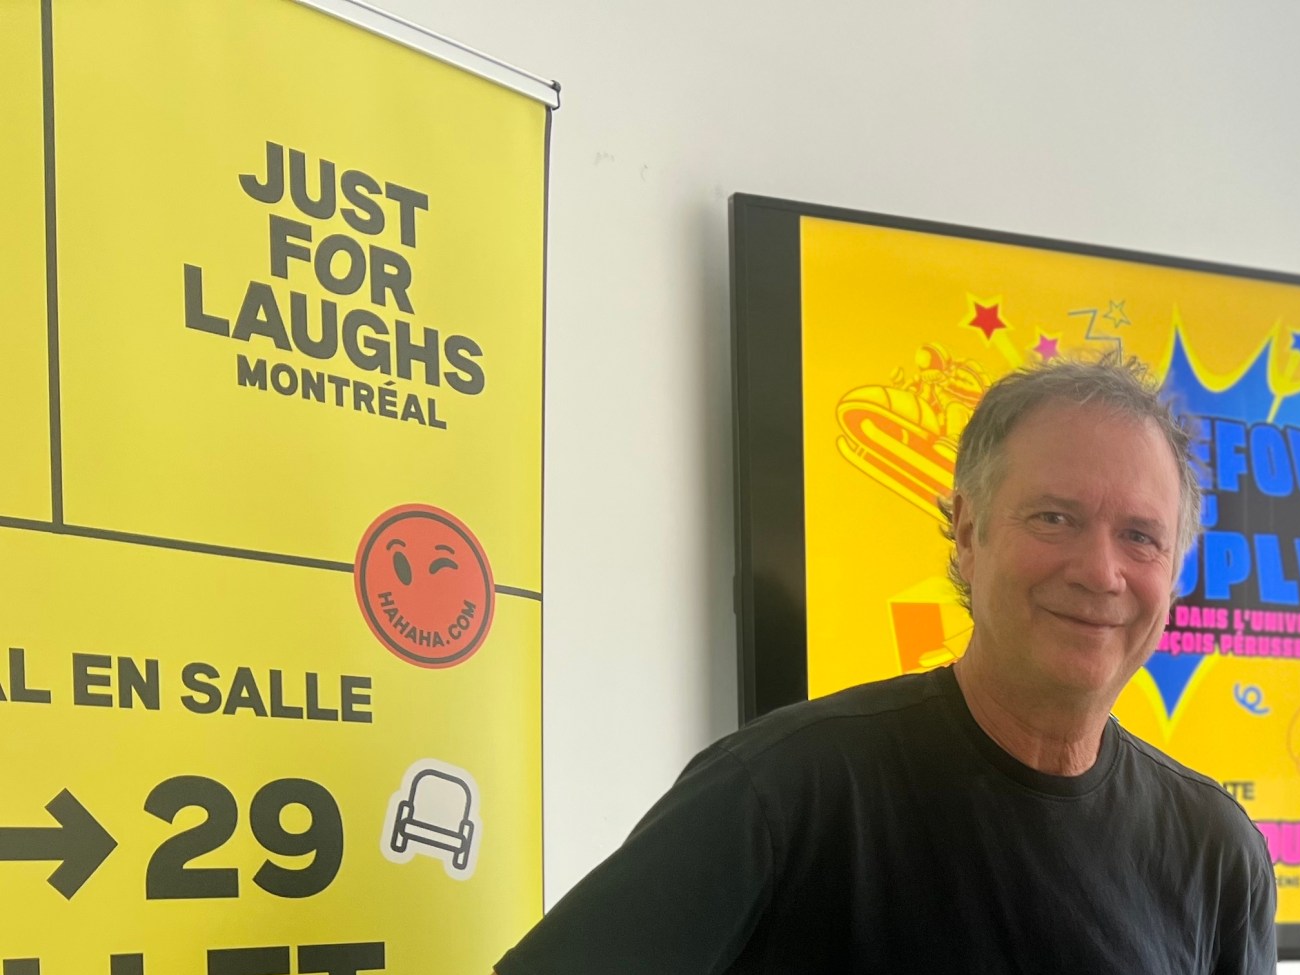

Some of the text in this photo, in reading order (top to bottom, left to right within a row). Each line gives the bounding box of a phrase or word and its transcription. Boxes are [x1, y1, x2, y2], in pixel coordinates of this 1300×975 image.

[238, 141, 428, 248] JUST
[268, 214, 414, 314] FOR
[184, 264, 485, 396] LAUGHS
[236, 354, 447, 430] MONTRÉAL
[378, 591, 477, 647] HAHAHA.COM
[1175, 605, 1229, 629] DANS
[72, 652, 160, 711] EN
[180, 662, 373, 724] SALLE
[143, 776, 344, 900] 29
